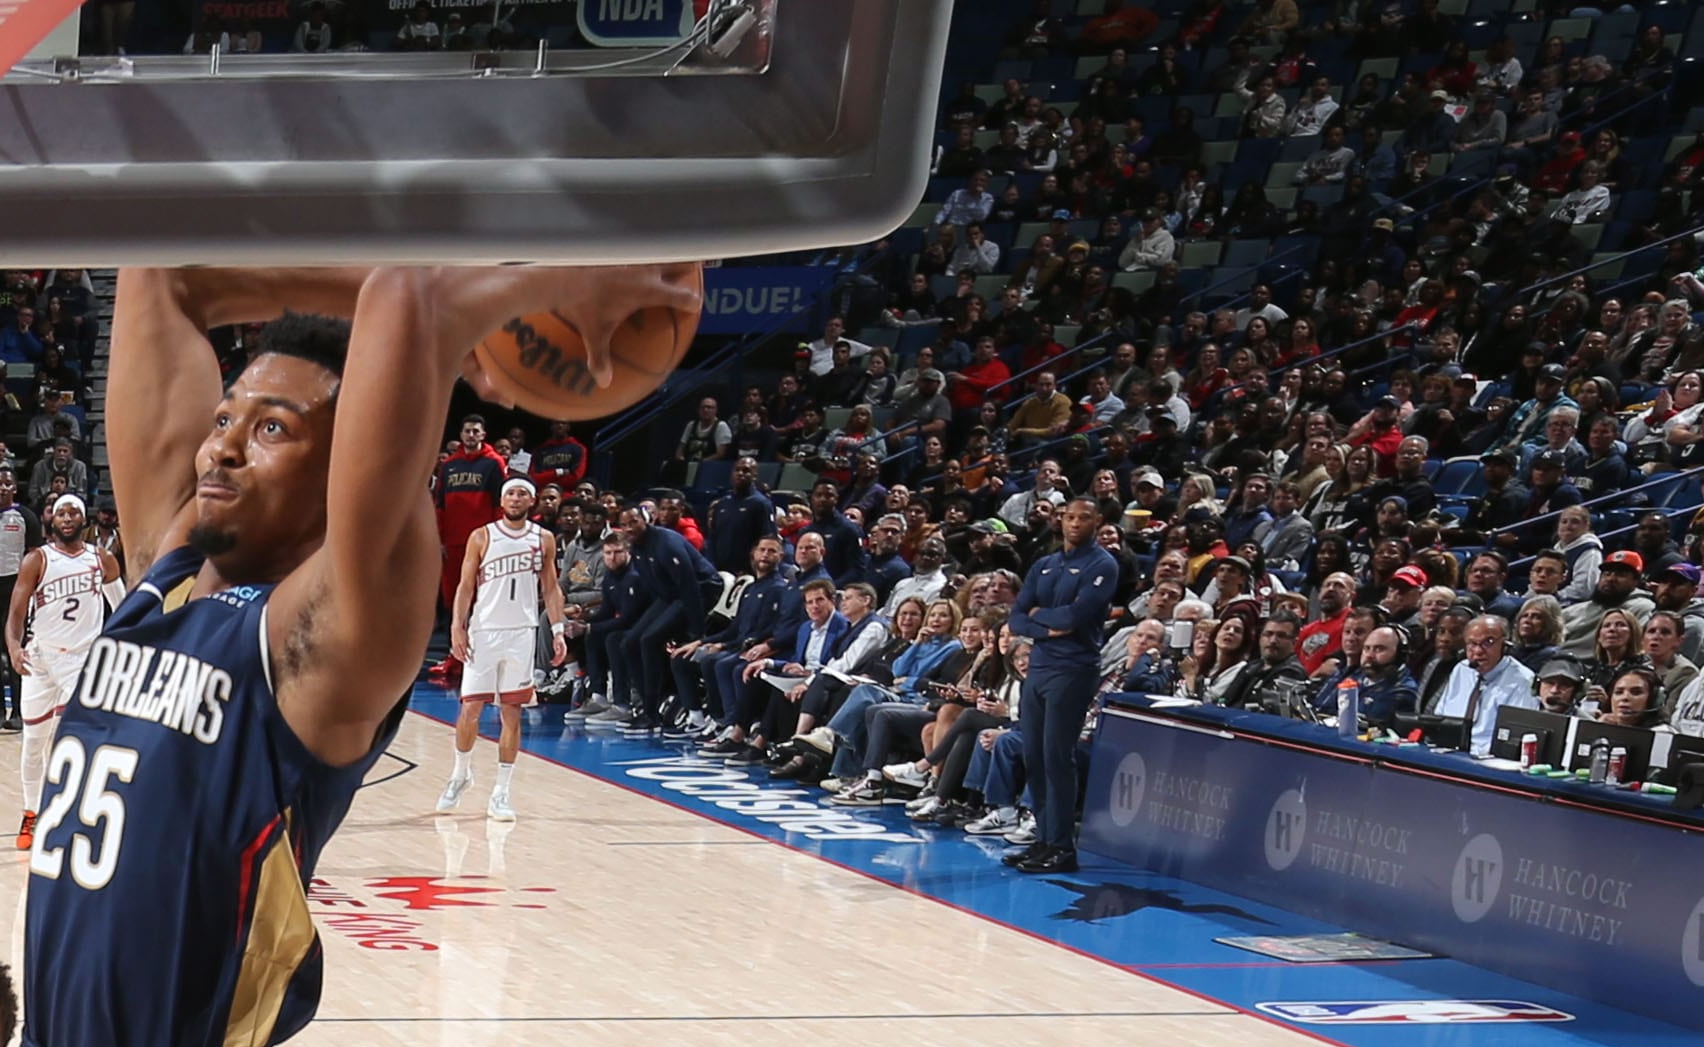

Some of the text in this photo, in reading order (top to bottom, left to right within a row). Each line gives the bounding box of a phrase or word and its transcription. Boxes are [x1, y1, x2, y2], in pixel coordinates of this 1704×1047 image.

[485, 553, 533, 580] SUNS
[43, 573, 93, 603] SUNS
[509, 578, 517, 601] 1
[62, 598, 80, 622] 2
[80, 636, 233, 745] ORLEANS
[1152, 770, 1234, 810] HANCOCK
[29, 735, 140, 891] 25
[1314, 810, 1412, 856] HANCOCK
[1512, 857, 1633, 910] HANCOCK
